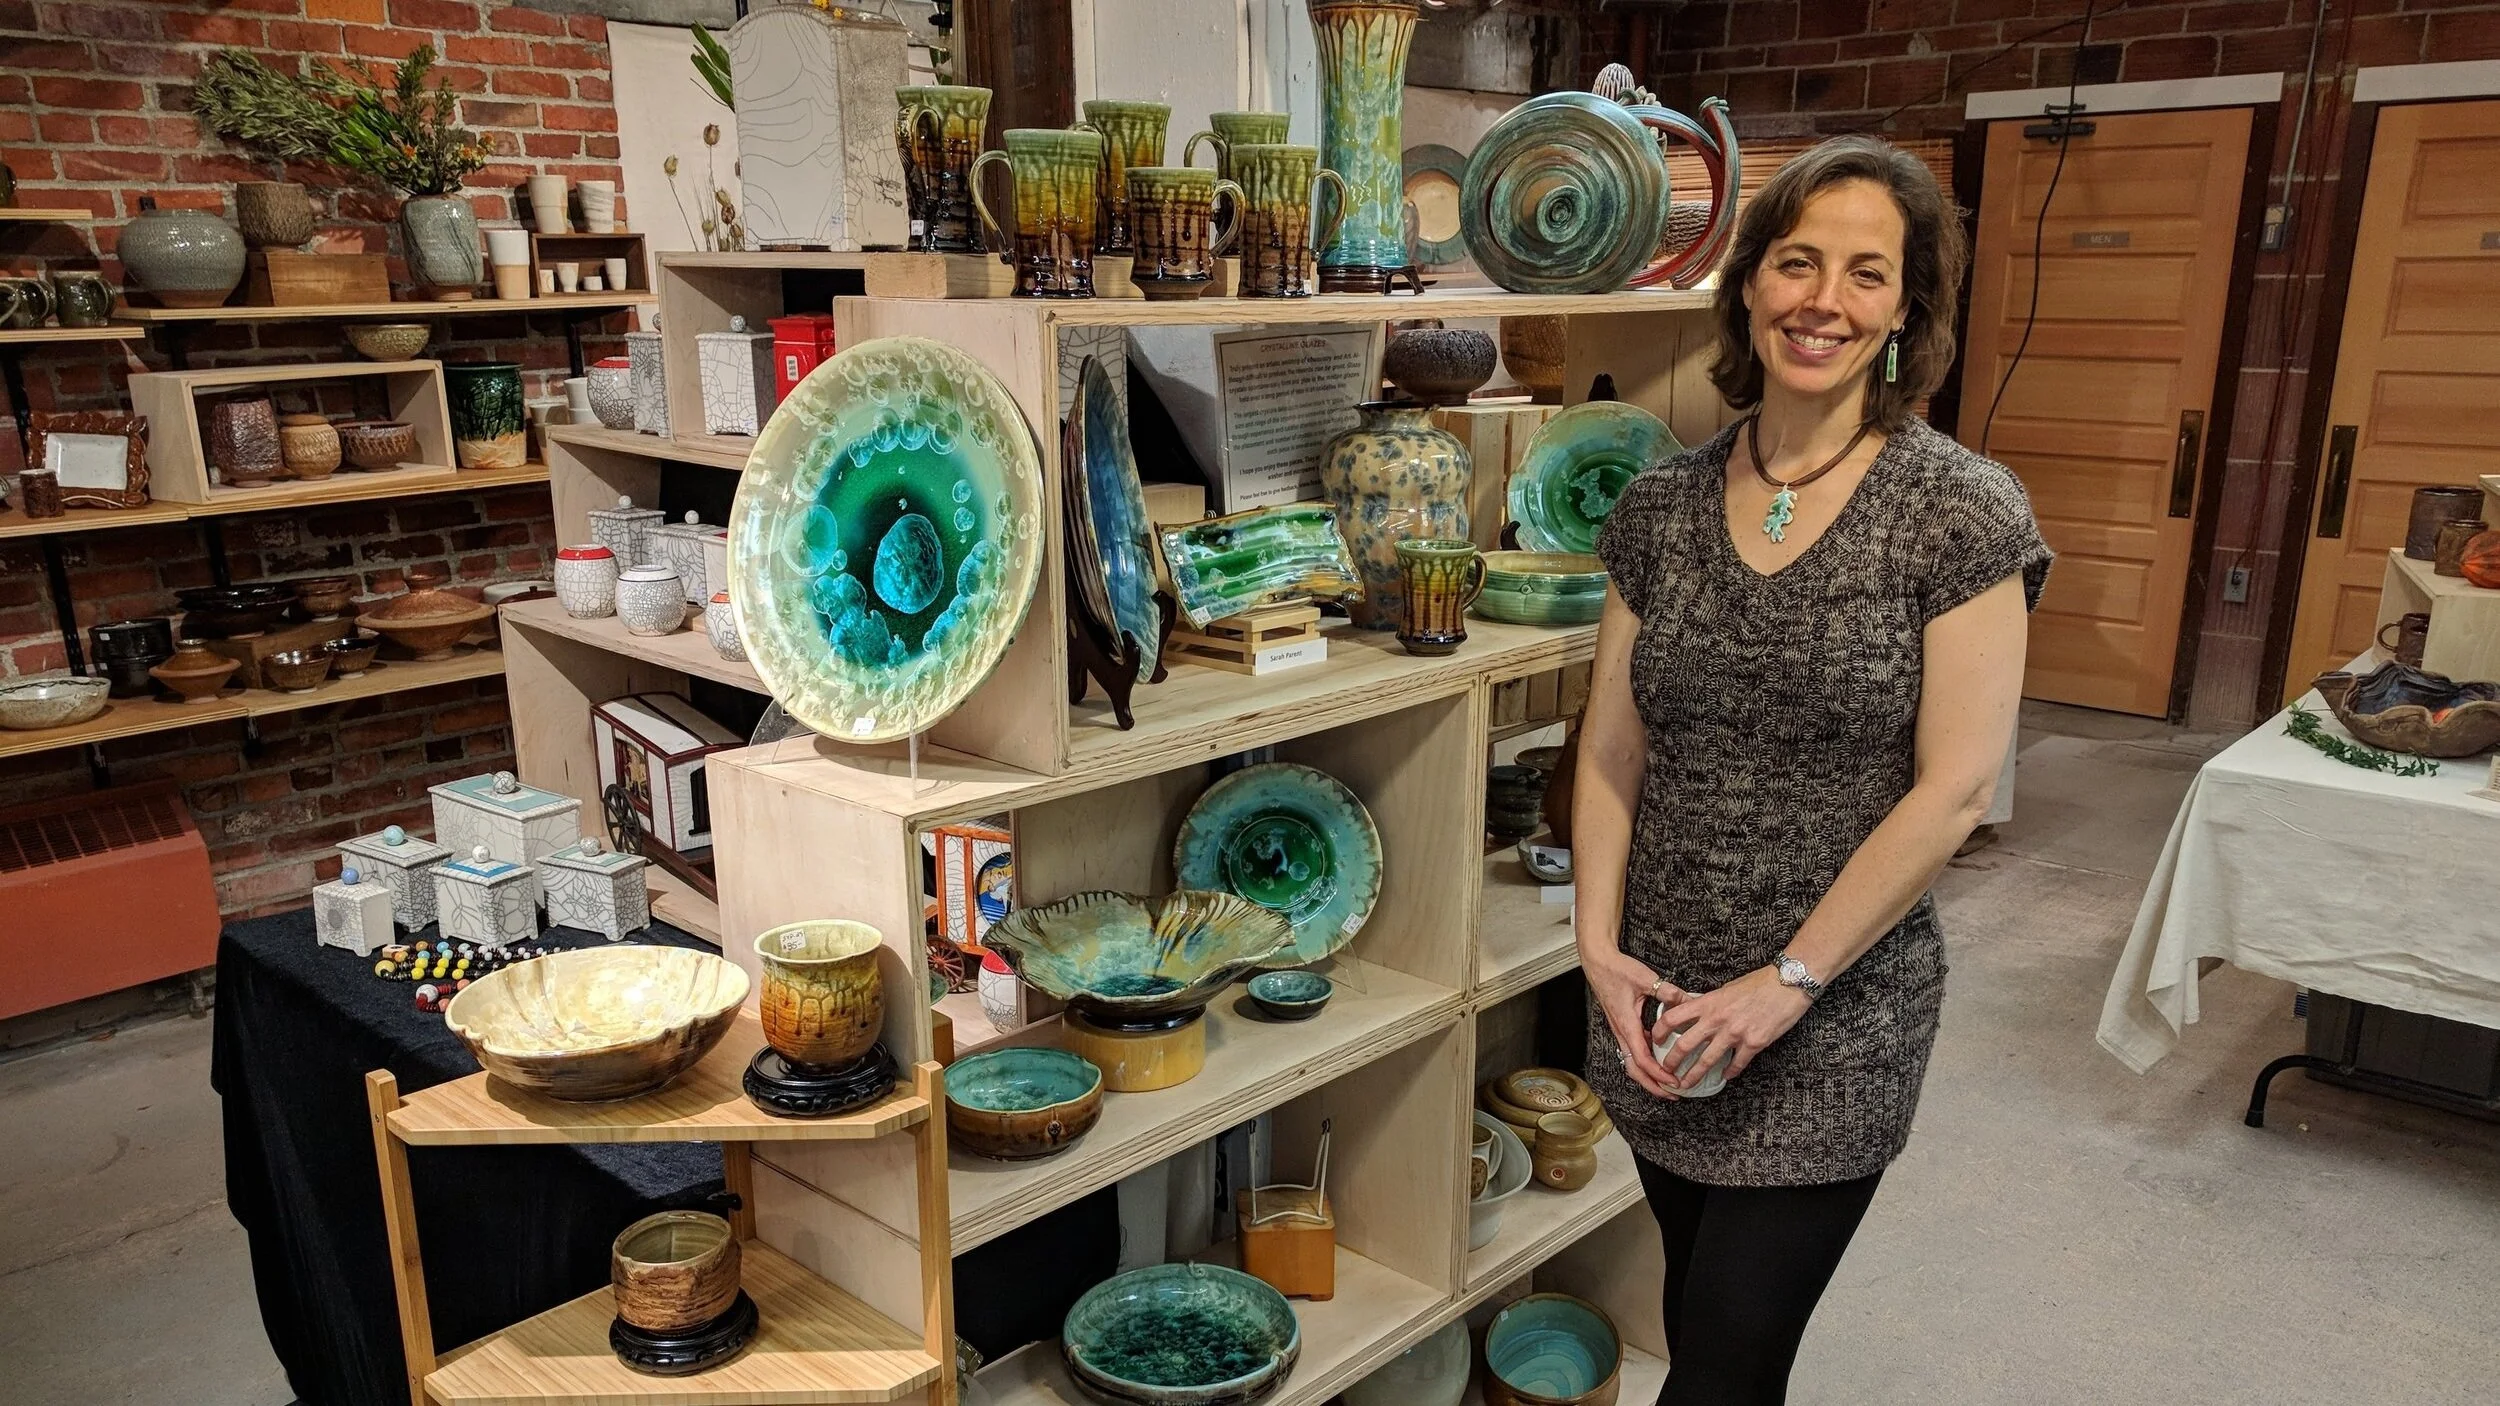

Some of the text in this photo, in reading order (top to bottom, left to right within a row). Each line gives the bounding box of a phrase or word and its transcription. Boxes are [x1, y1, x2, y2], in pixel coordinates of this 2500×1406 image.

[2090, 234, 2112, 243] MEN
[1260, 339, 1326, 352] CRYSTALLINE GLAZES
[1243, 466, 1253, 474] hope
[1254, 465, 1262, 473] you
[1263, 463, 1275, 471] enjoy
[1276, 460, 1288, 468] these
[1304, 454, 1315, 463] They
[1284, 469, 1292, 477] and
[1270, 650, 1303, 662] Sarah Parent
